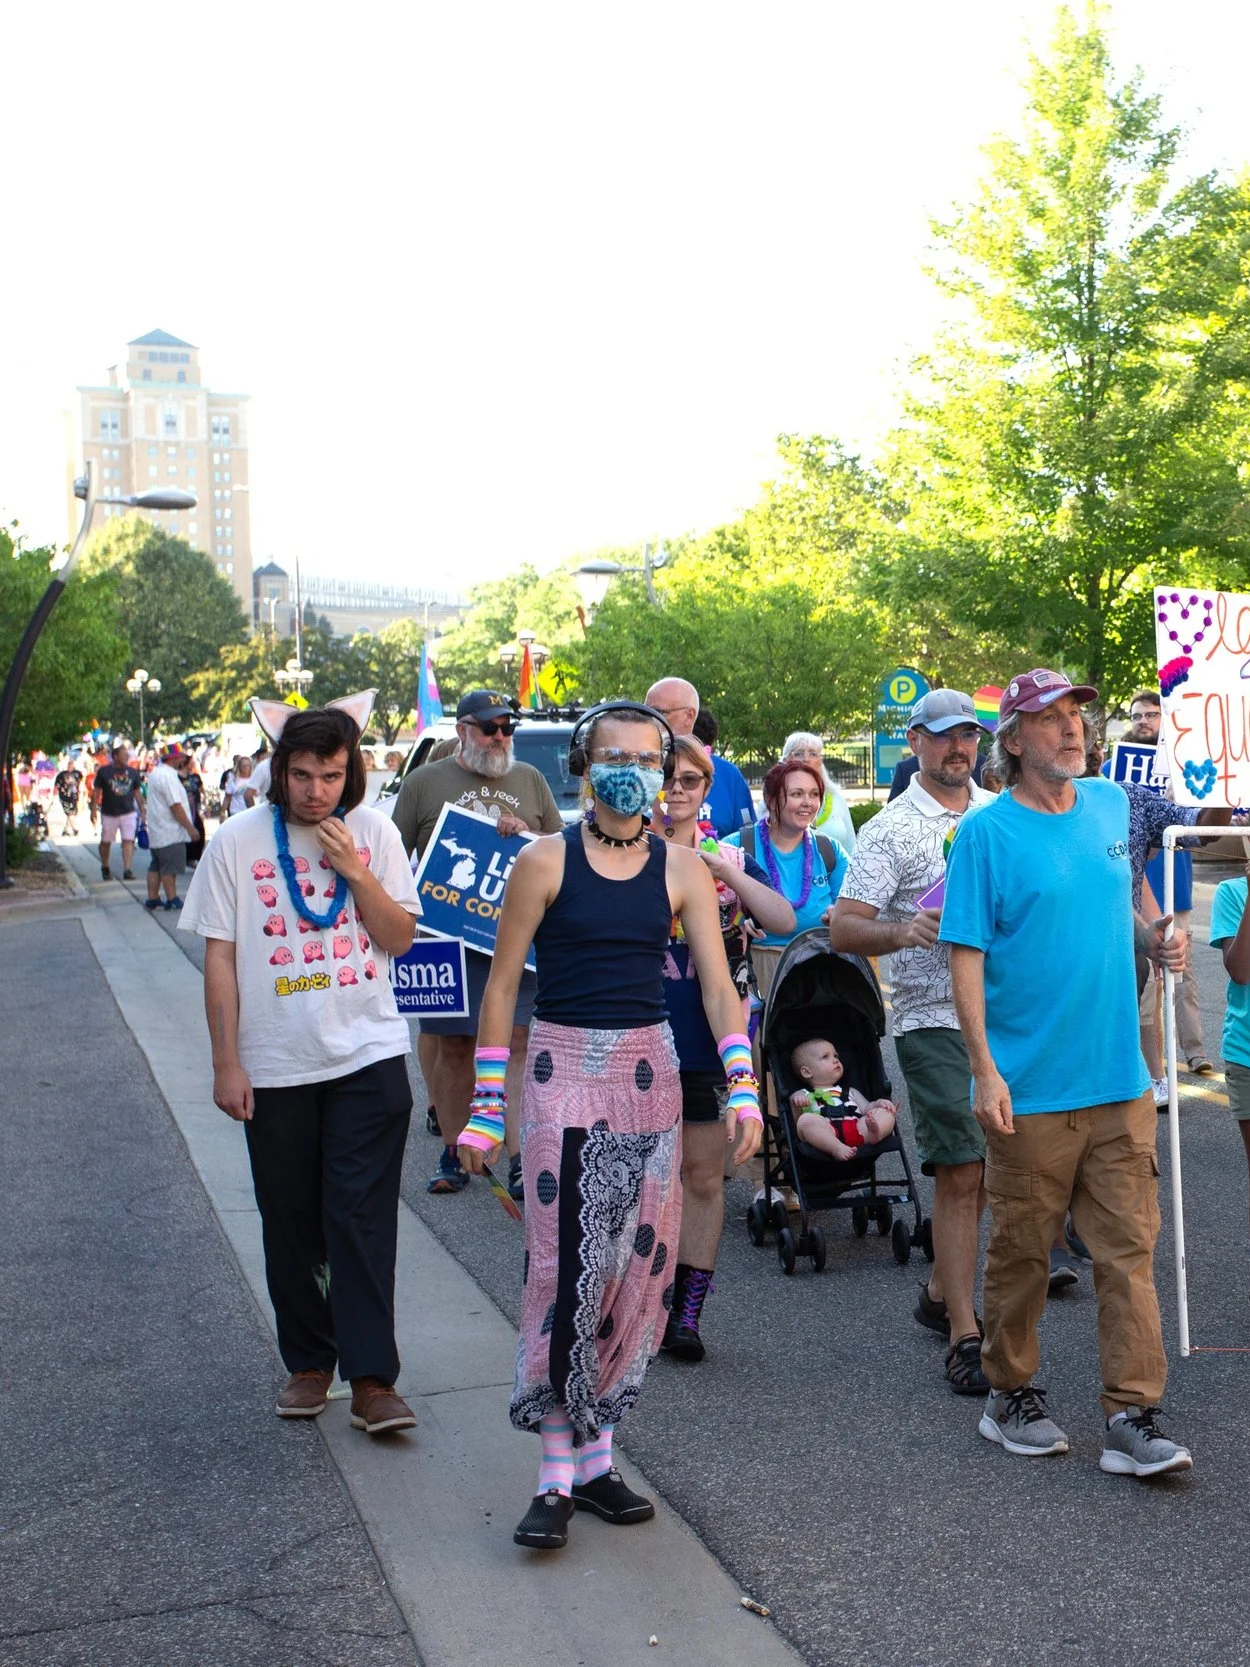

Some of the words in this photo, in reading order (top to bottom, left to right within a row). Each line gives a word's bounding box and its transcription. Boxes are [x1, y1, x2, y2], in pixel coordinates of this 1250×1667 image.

[481, 786, 490, 797] &
[493, 790, 520, 808] seek
[421, 880, 461, 908] FOR
[395, 989, 455, 1006] esentative
